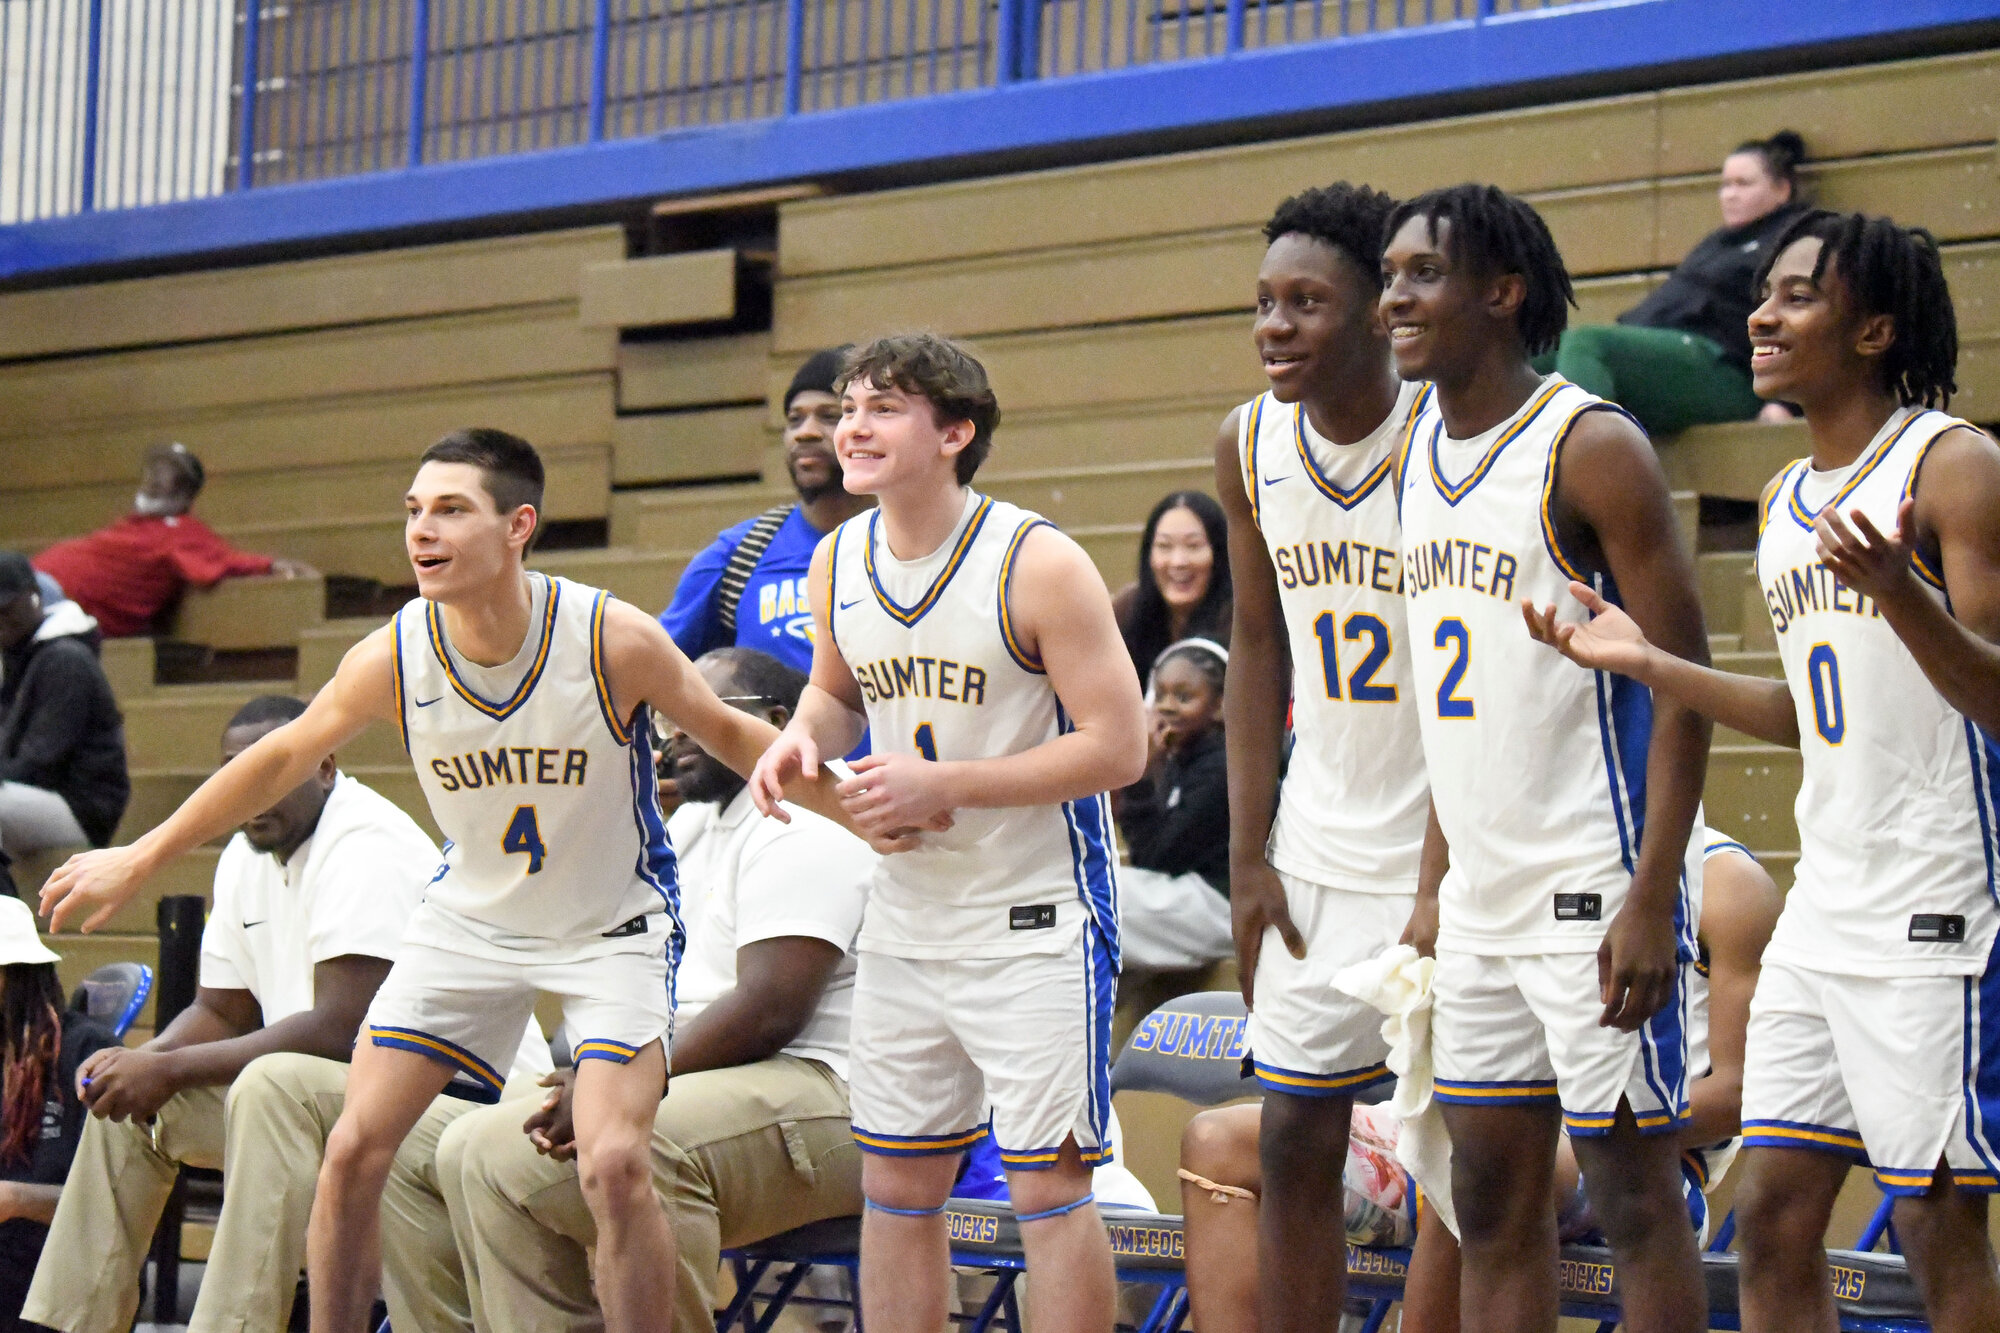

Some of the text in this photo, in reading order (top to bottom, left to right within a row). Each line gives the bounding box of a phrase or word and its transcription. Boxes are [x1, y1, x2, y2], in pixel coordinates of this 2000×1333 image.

[1276, 540, 1405, 596] SUMTE
[1406, 537, 1518, 601] SUMTER
[856, 655, 987, 706] SUMTER
[1312, 609, 1400, 703] 12
[1433, 616, 1476, 720] 2
[1807, 640, 1847, 748] 0
[913, 721, 938, 762] 1
[430, 747, 589, 792] SUMTER
[500, 803, 548, 876] 4
[632, 920, 641, 929] M
[1041, 911, 1050, 921] M
[1583, 901, 1594, 912] M
[1947, 923, 1956, 934] S
